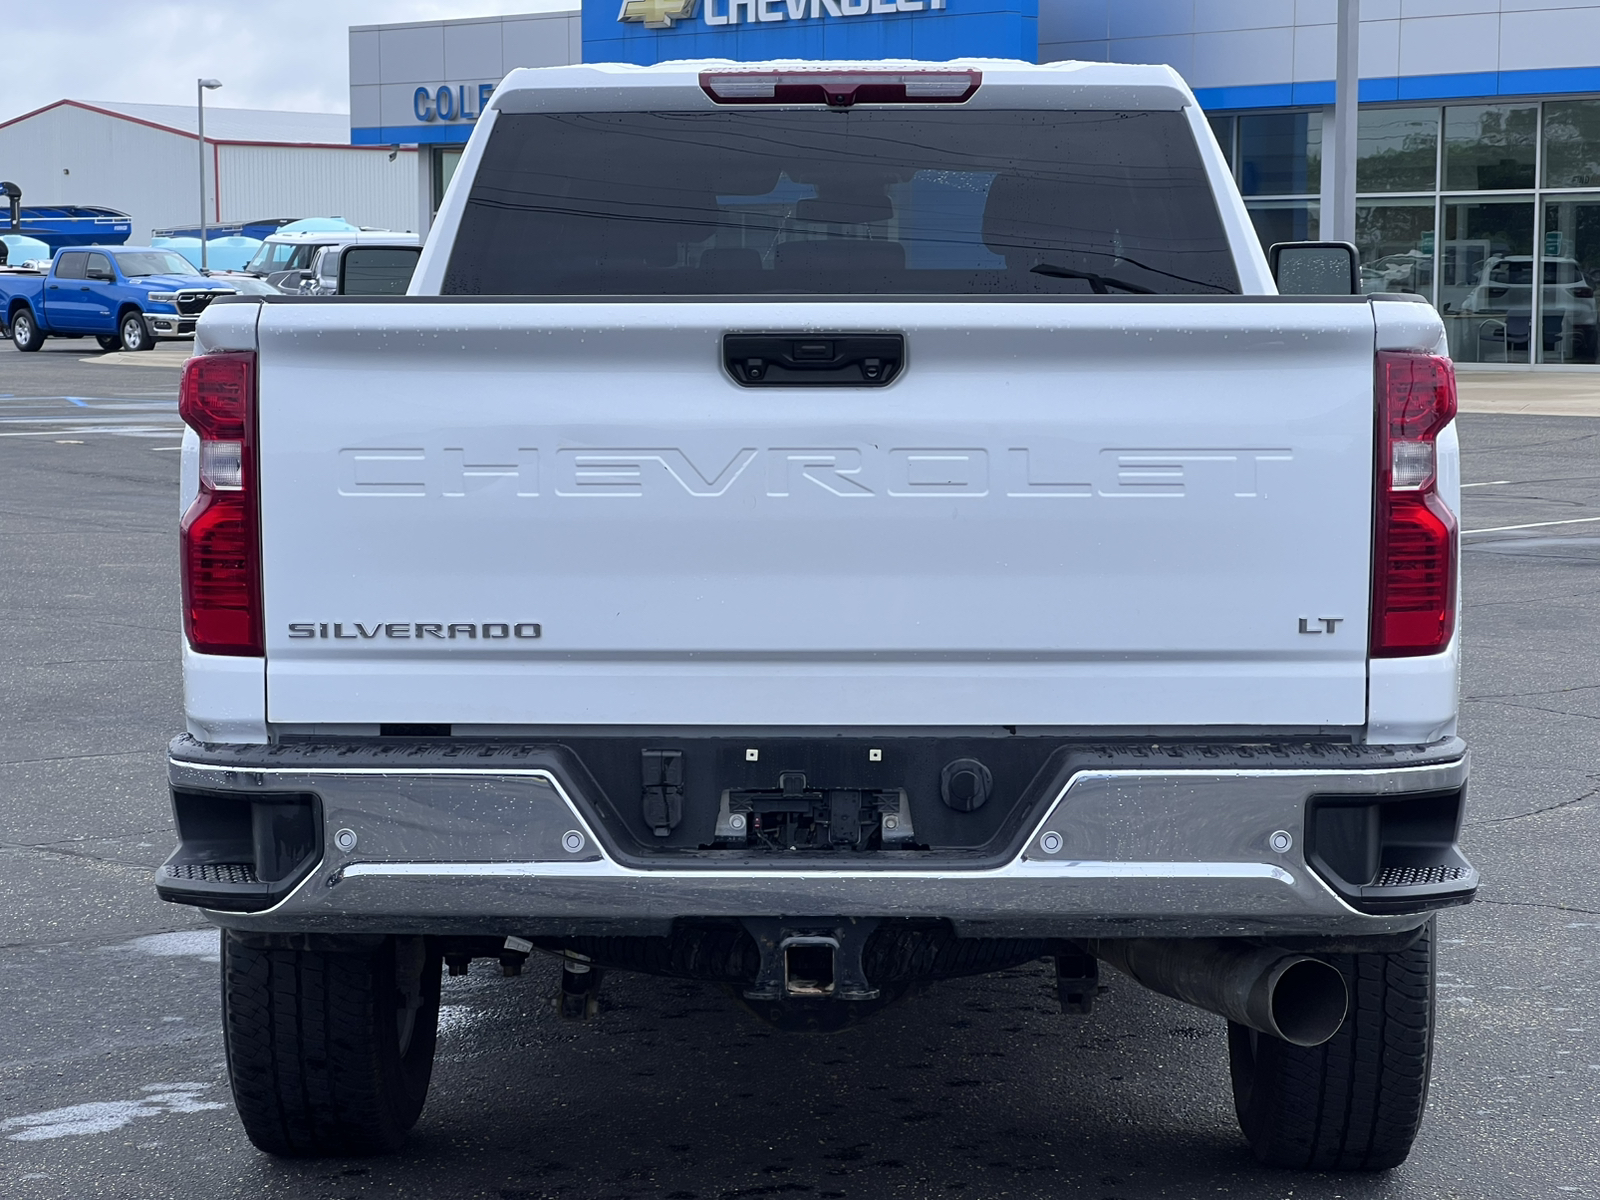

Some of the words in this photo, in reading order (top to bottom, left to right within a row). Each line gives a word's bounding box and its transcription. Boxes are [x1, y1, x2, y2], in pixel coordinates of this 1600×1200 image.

[338, 447, 1293, 497] CHEVROLET
[288, 622, 541, 639] SILVERADO
[1298, 617, 1344, 634] LT
